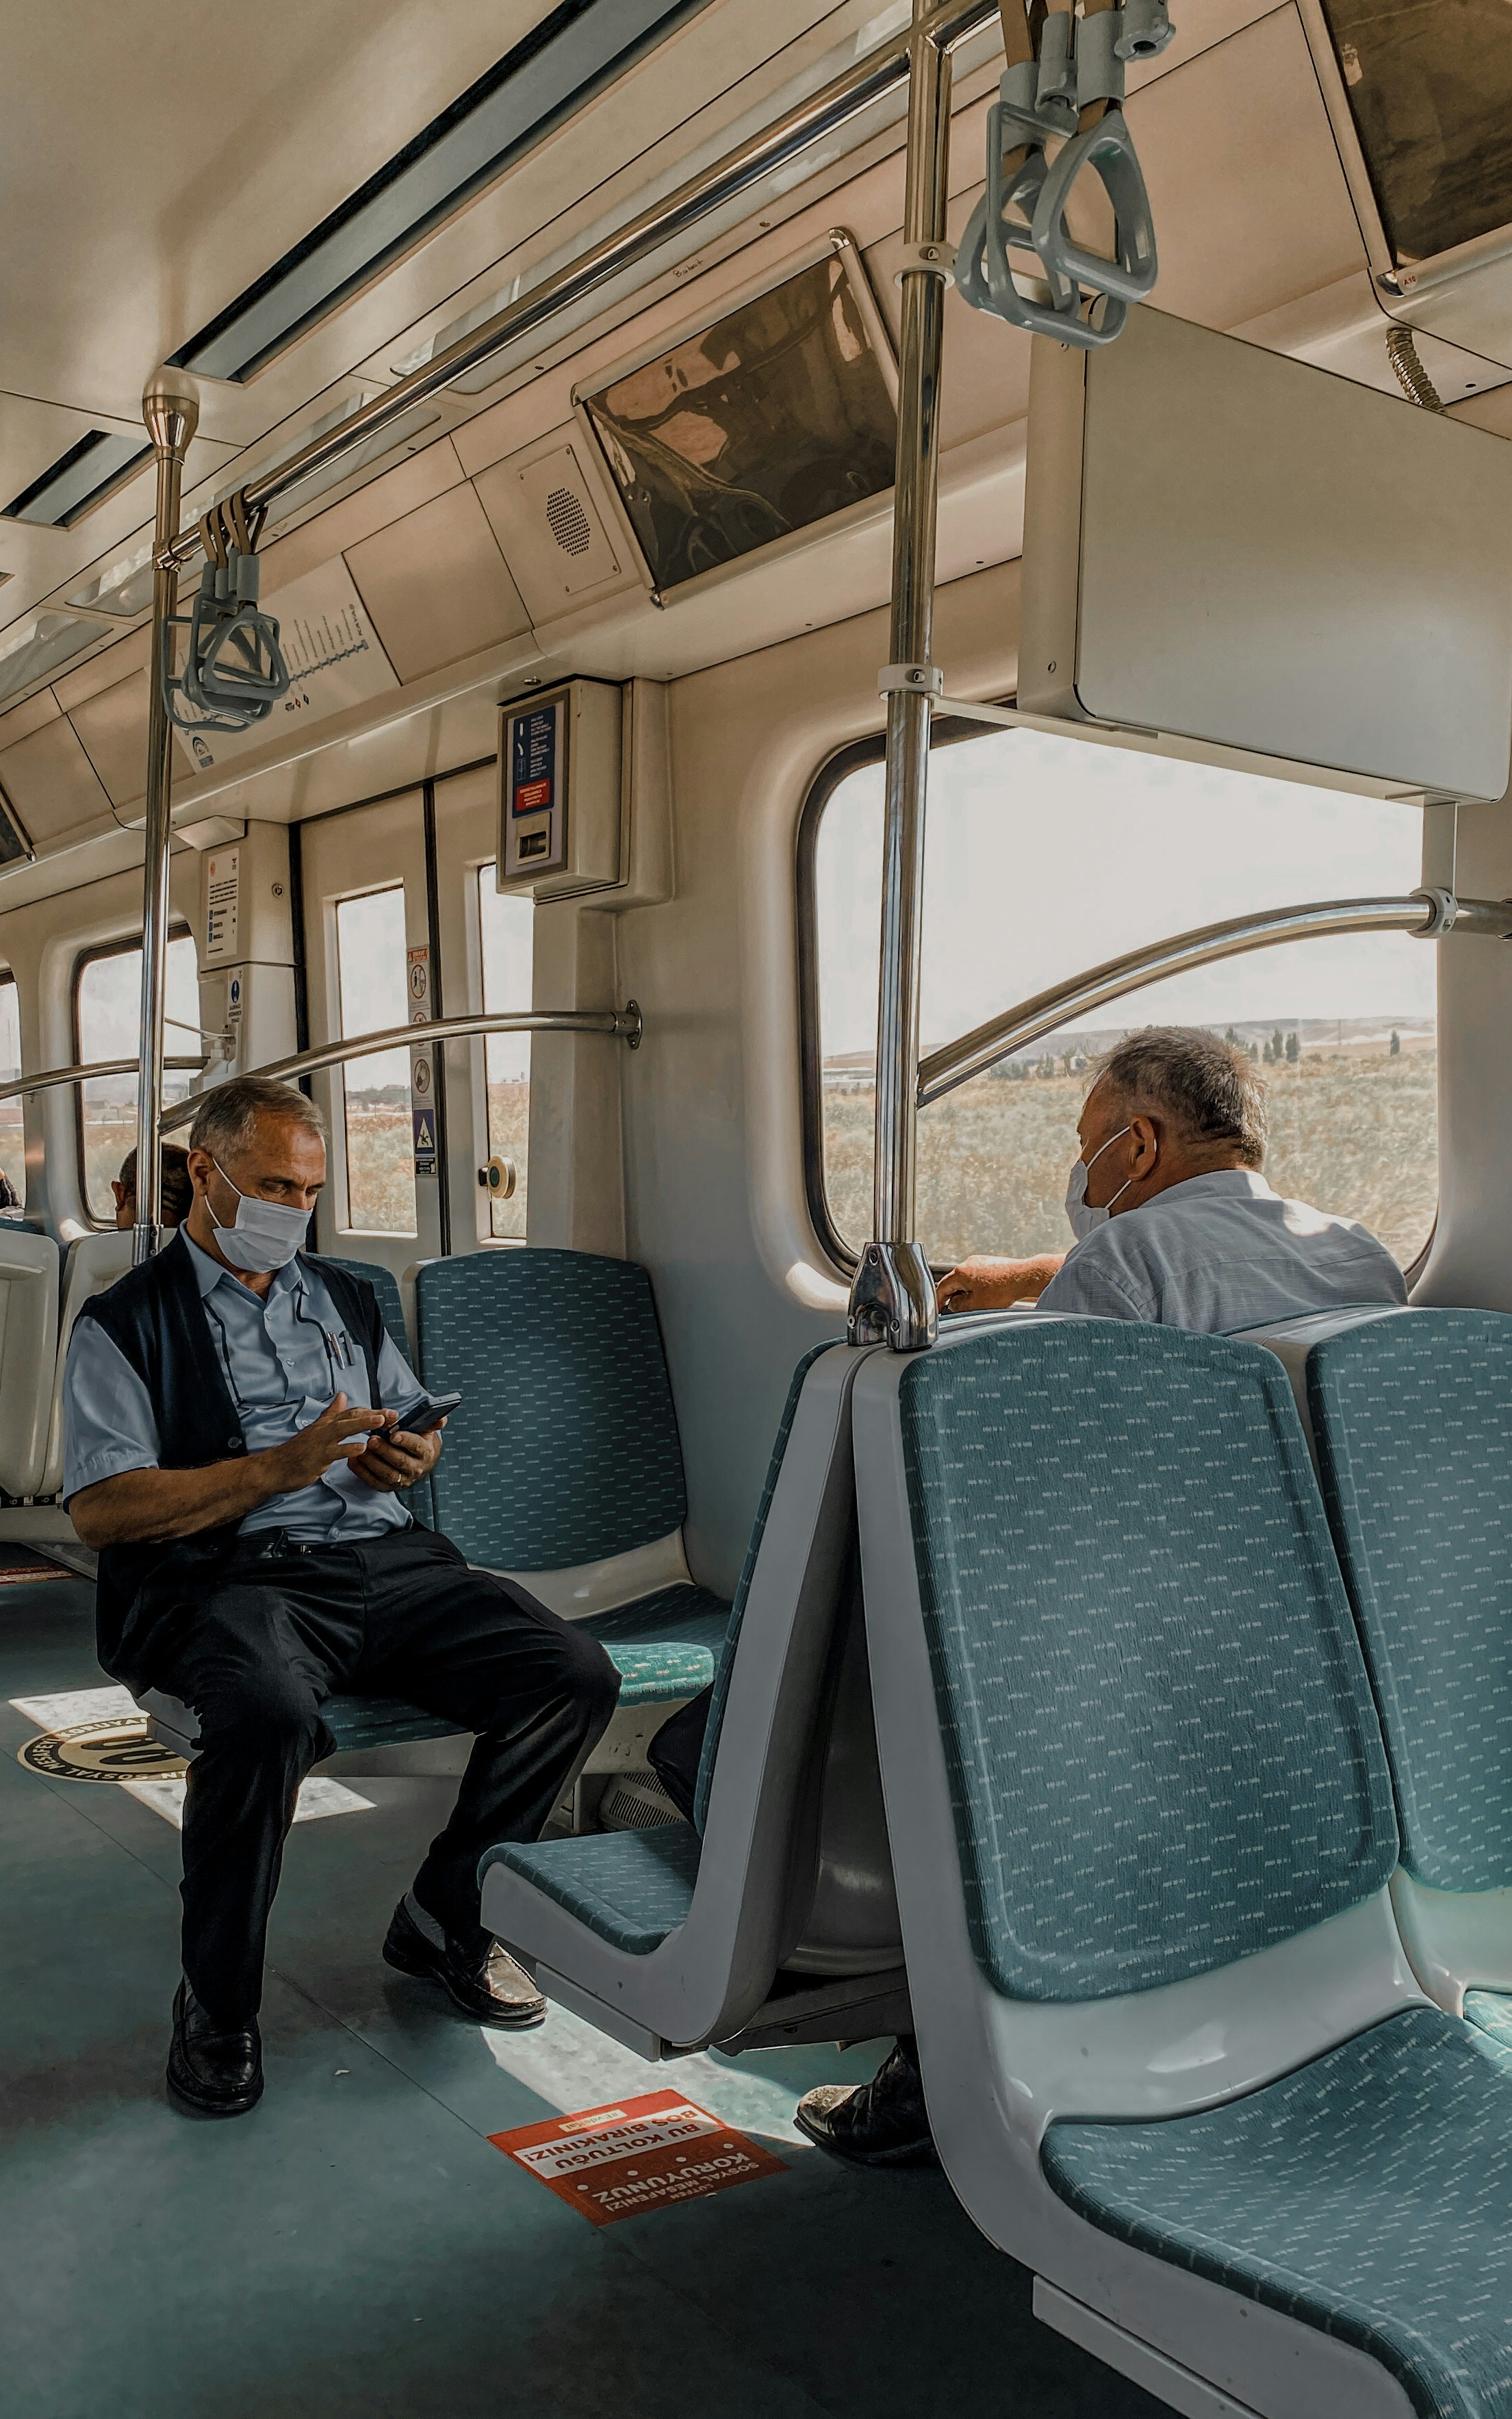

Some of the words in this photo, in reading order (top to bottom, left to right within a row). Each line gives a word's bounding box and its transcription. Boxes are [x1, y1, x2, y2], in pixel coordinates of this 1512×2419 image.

[65, 1767, 148, 1780] SOSYAL
[524, 2123, 650, 2162] BIRAKINIZ!
[668, 2123, 701, 2138] BU
[555, 2134, 665, 2168] KOLTUĞU
[592, 2152, 750, 2203] KORUYUNUZ
[700, 2162, 759, 2181] SOSYAL
[605, 2179, 700, 2212] MESAFENİZİ
